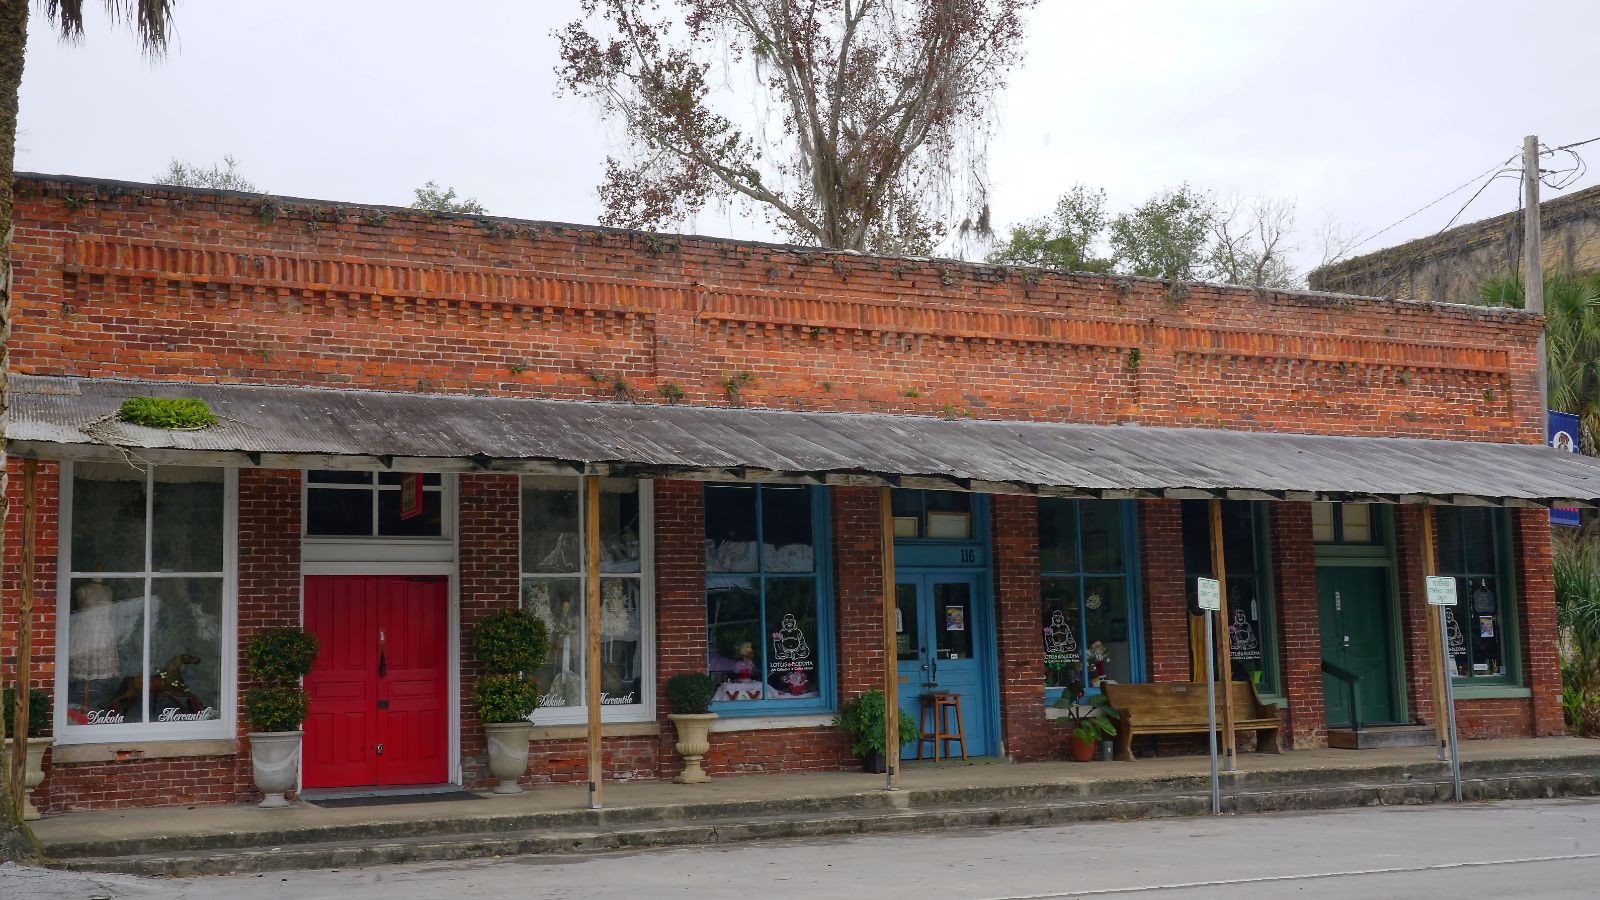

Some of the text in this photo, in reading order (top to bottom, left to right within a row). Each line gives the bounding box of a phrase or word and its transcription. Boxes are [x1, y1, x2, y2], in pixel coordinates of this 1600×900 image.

[960, 549, 975, 563] 116
[87, 709, 124, 724] Dakota
[158, 706, 212, 722] Mercantile
